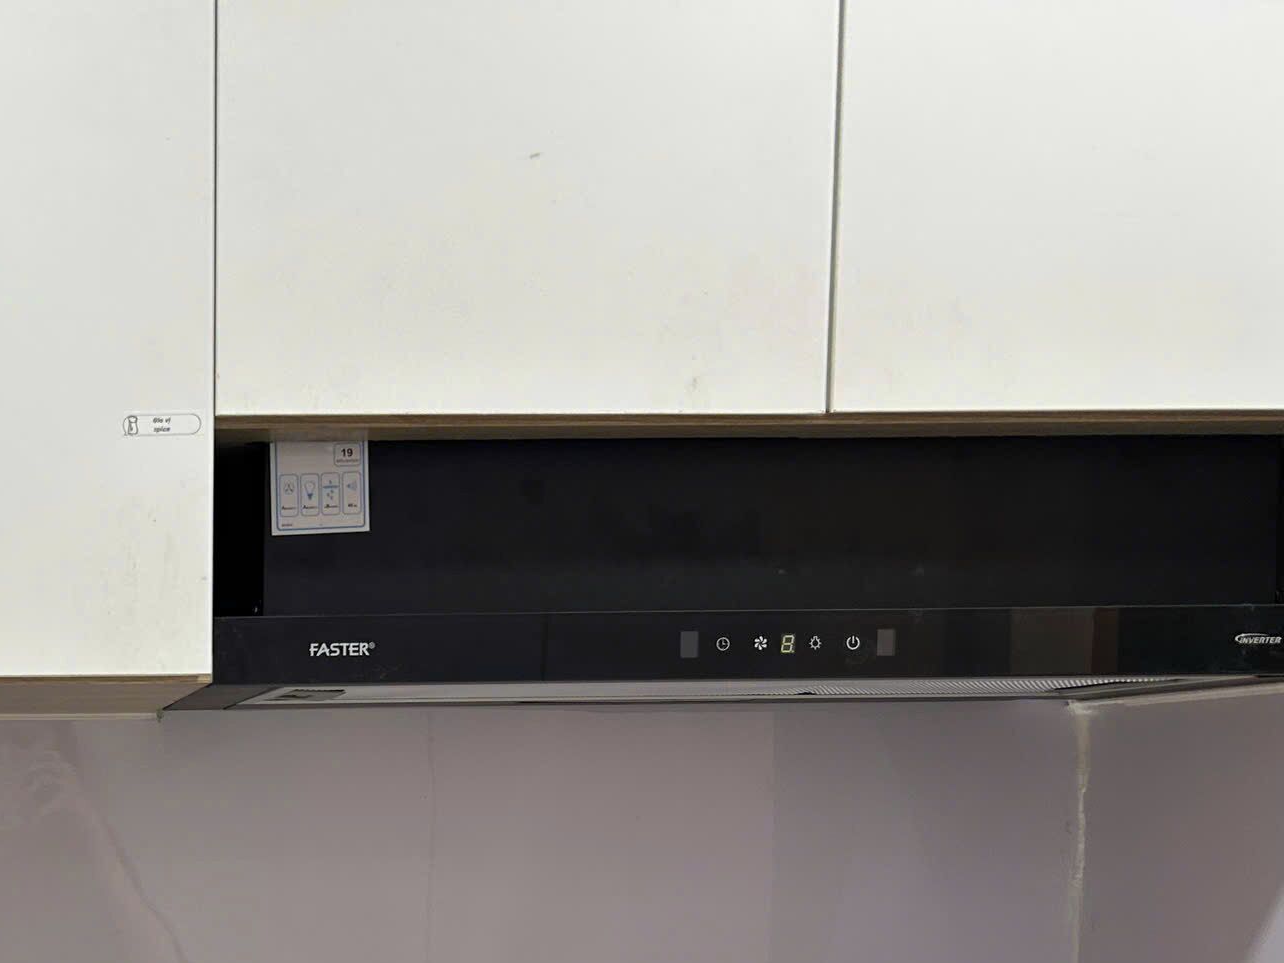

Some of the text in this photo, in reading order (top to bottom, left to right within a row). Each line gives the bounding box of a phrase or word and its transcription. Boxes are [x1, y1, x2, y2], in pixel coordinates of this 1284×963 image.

[340, 448, 353, 457] 19
[1239, 636, 1282, 644] INVERTER
[309, 642, 370, 656] FASTER
